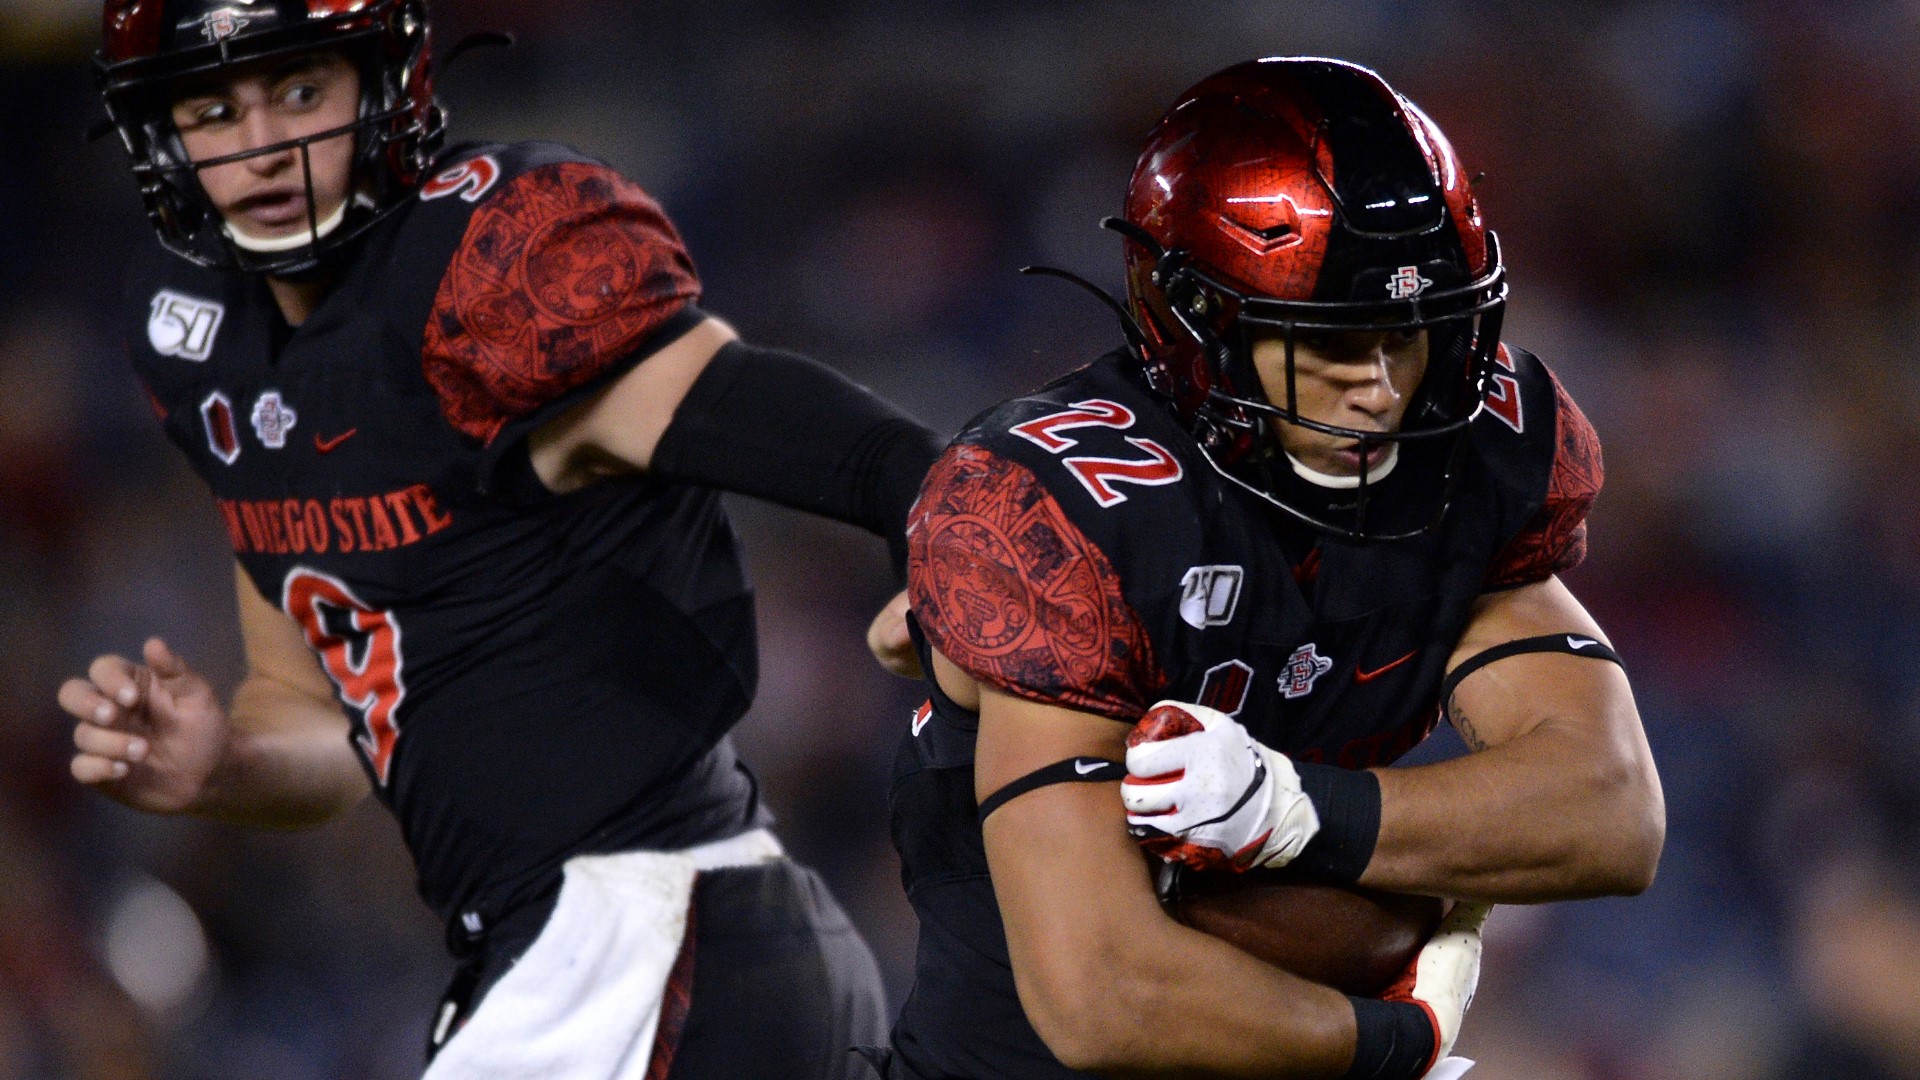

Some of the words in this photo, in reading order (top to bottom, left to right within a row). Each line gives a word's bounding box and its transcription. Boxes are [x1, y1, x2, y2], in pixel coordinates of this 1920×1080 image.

[420, 155, 499, 202] 9
[1008, 398, 1183, 508] 22
[330, 483, 454, 553] STATE
[282, 566, 406, 787] 9
